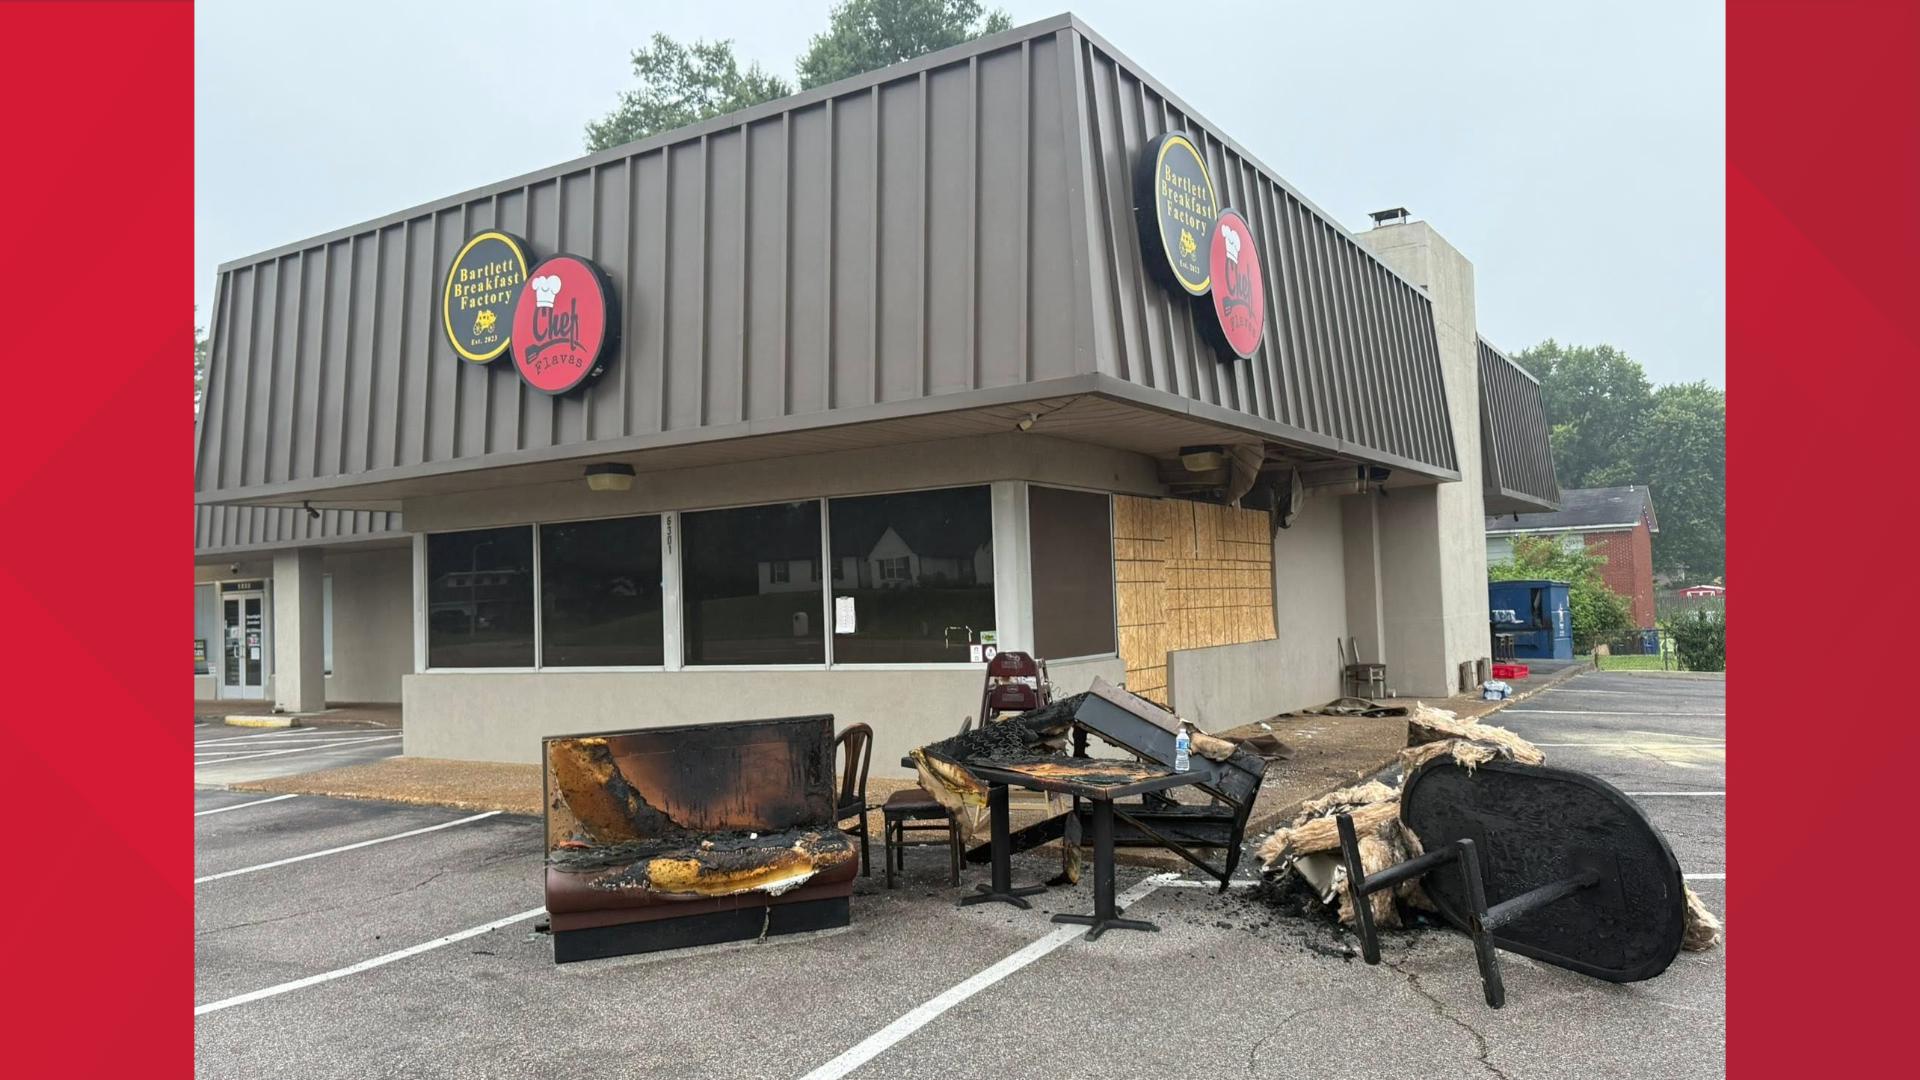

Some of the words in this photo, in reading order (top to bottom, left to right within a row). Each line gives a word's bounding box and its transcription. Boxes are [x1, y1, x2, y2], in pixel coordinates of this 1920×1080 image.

[1161, 180, 1211, 219] Breakfast
[1165, 164, 1206, 200] Bartlett
[1167, 200, 1207, 237] Factory
[454, 272, 519, 298] Breakfast
[460, 260, 513, 282] Bartlett
[1225, 257, 1252, 319] Chef
[461, 290, 512, 310] Factory
[532, 298, 579, 352] Chef
[535, 354, 583, 376] Flavas
